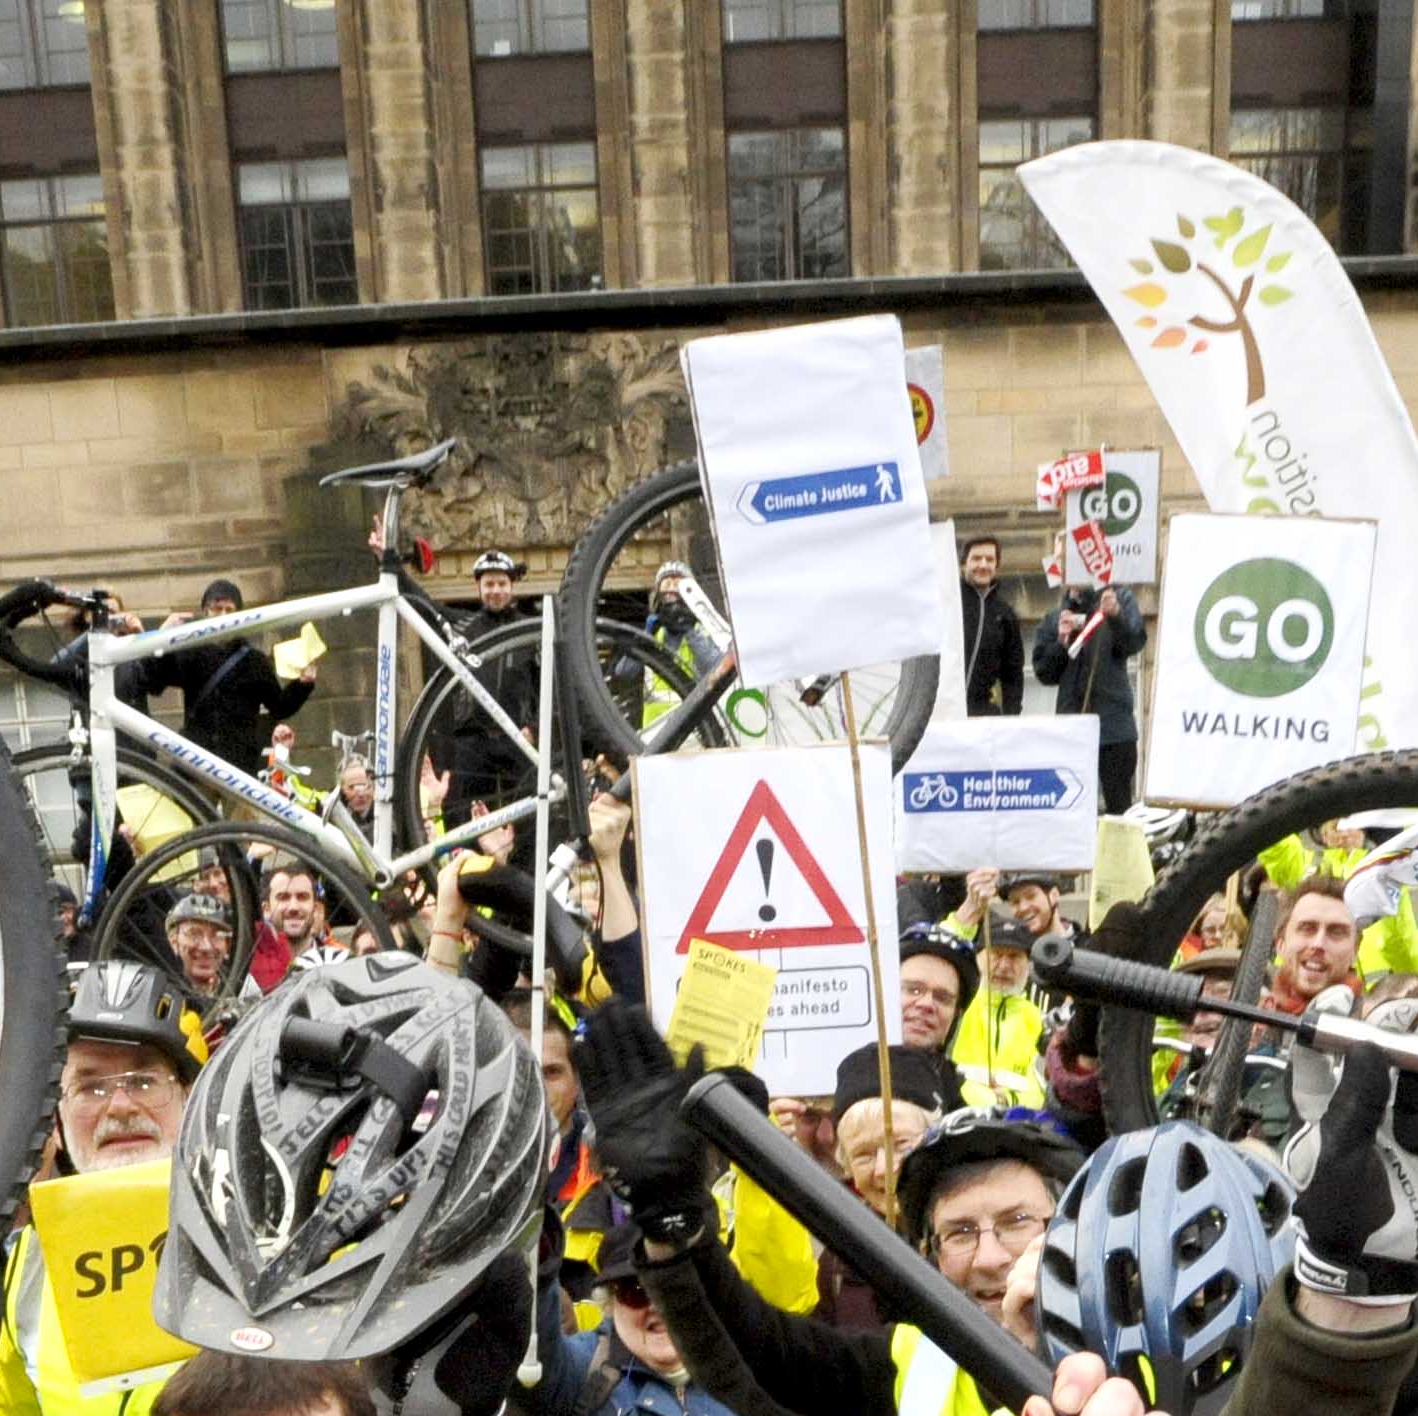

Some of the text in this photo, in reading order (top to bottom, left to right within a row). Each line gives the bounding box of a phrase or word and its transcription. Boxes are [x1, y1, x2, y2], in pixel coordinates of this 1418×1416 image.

[764, 482, 868, 512] Climate Justice
[1083, 488, 1139, 521] GO
[1204, 594, 1325, 664] GO
[1181, 710, 1331, 743] WALKING
[963, 775, 1032, 792] Healthier
[963, 791, 1057, 810] Environment
[790, 999, 841, 1016] ahead
